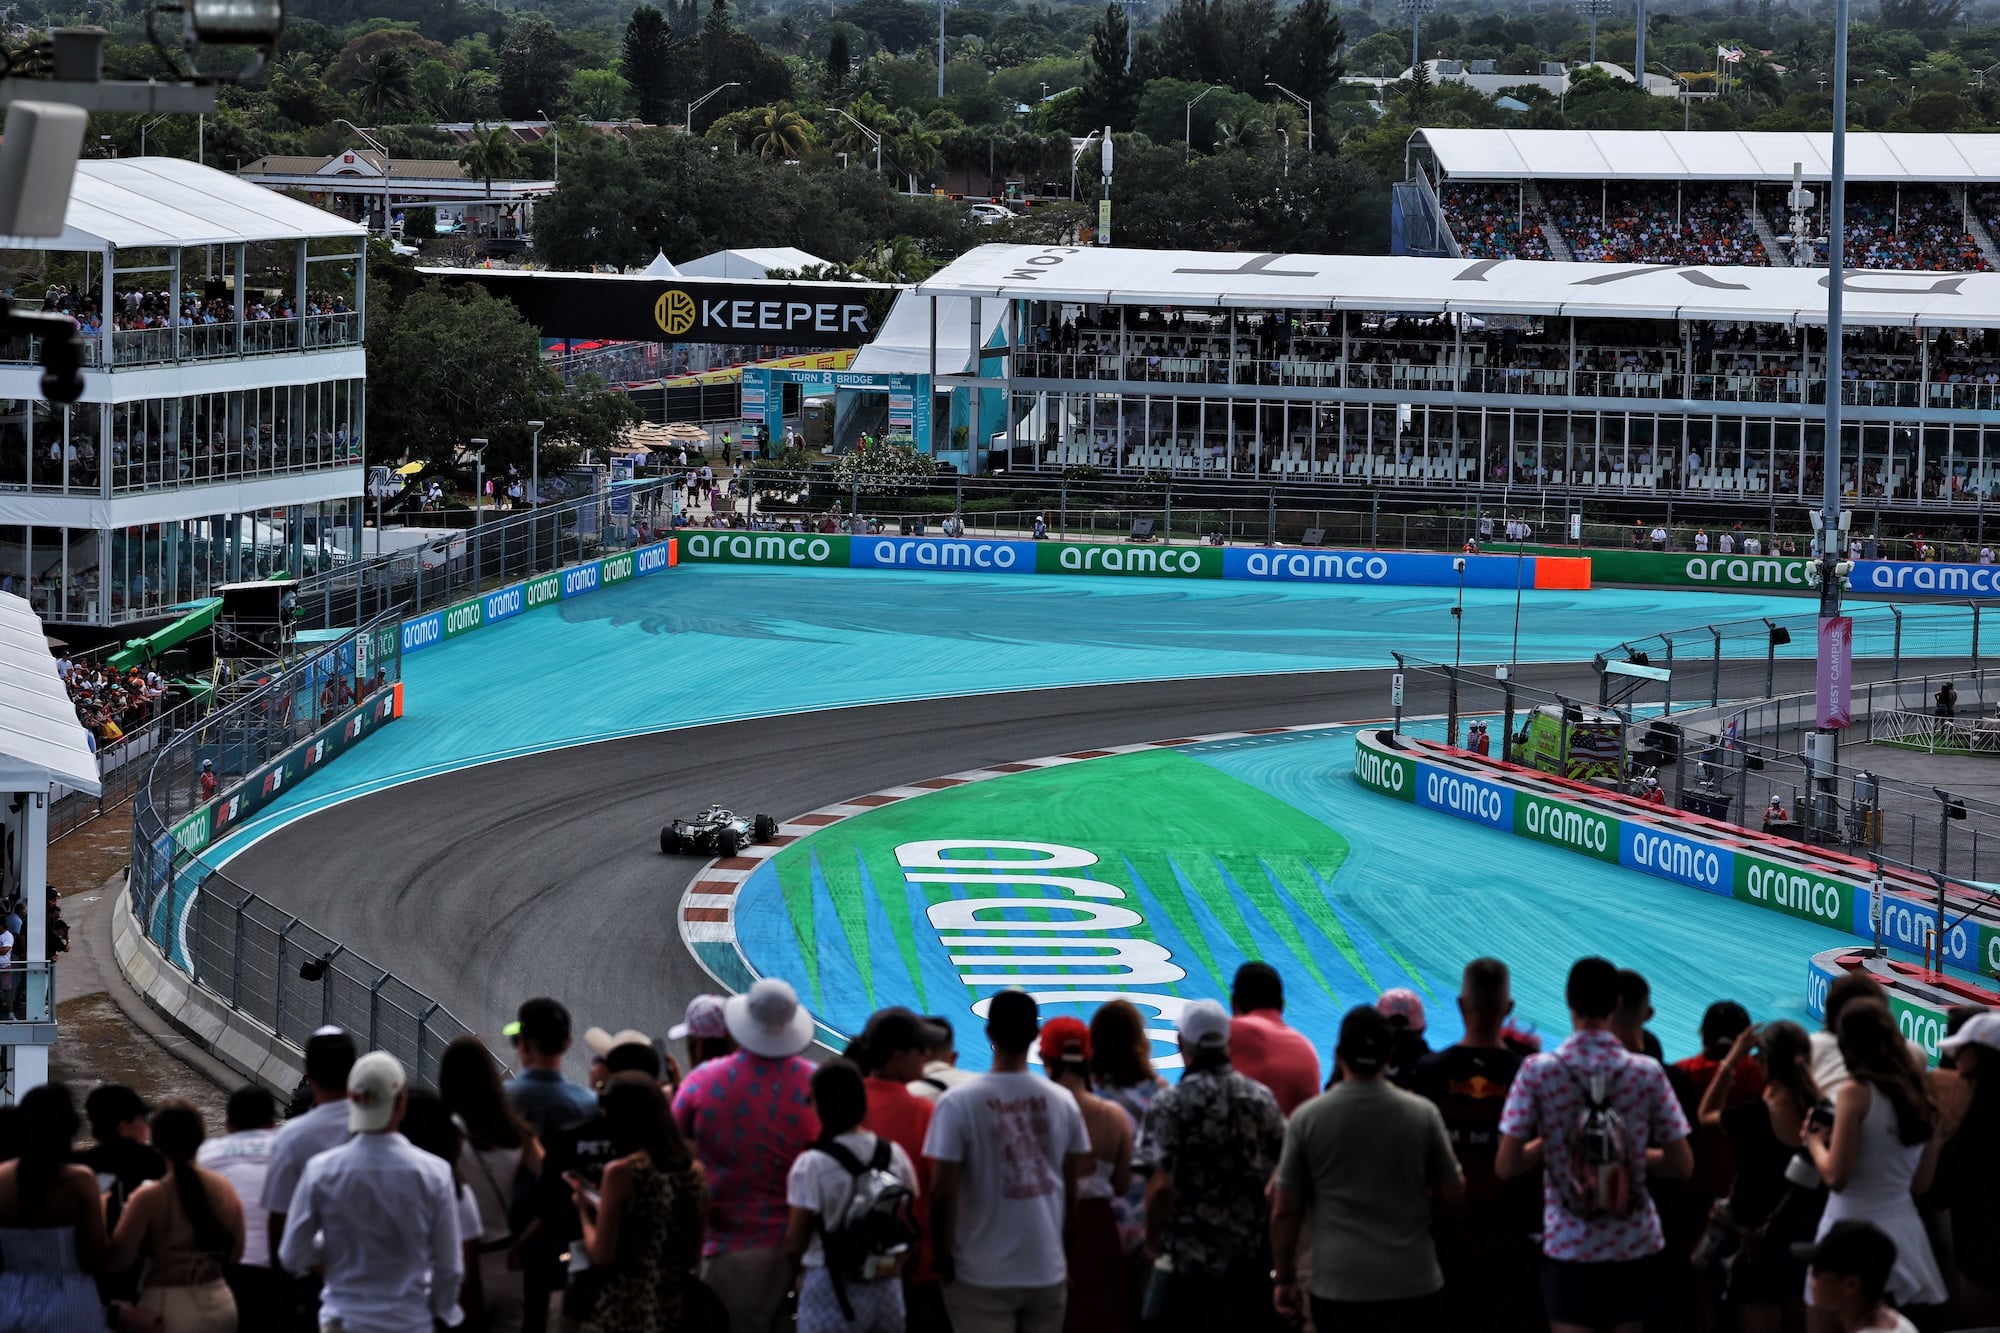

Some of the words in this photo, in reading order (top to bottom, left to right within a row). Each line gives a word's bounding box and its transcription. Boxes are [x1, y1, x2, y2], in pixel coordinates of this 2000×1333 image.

[702, 299, 869, 333] KEEPER
[791, 372, 818, 382] TURN
[822, 372, 833, 384] 8
[836, 375, 873, 384] BRIDGE
[639, 547, 666, 571] aramco
[688, 534, 830, 561] aramco
[874, 540, 1016, 568] aramco
[1060, 547, 1201, 573] aramco
[566, 565, 596, 593] aramco
[603, 556, 632, 582] aramco
[1247, 553, 1388, 579] aramco
[1686, 558, 1814, 583] aramc
[488, 589, 520, 619] aramco
[527, 578, 559, 606] aramco
[404, 617, 438, 648] aramco
[447, 603, 480, 633] aramco
[1831, 631, 1840, 681] CAMPUS
[1830, 683, 1839, 715] WEST
[1427, 772, 1502, 822] aramco
[1526, 801, 1607, 852] aramco
[1633, 832, 1719, 886] aramco
[1747, 864, 1840, 920] aramco
